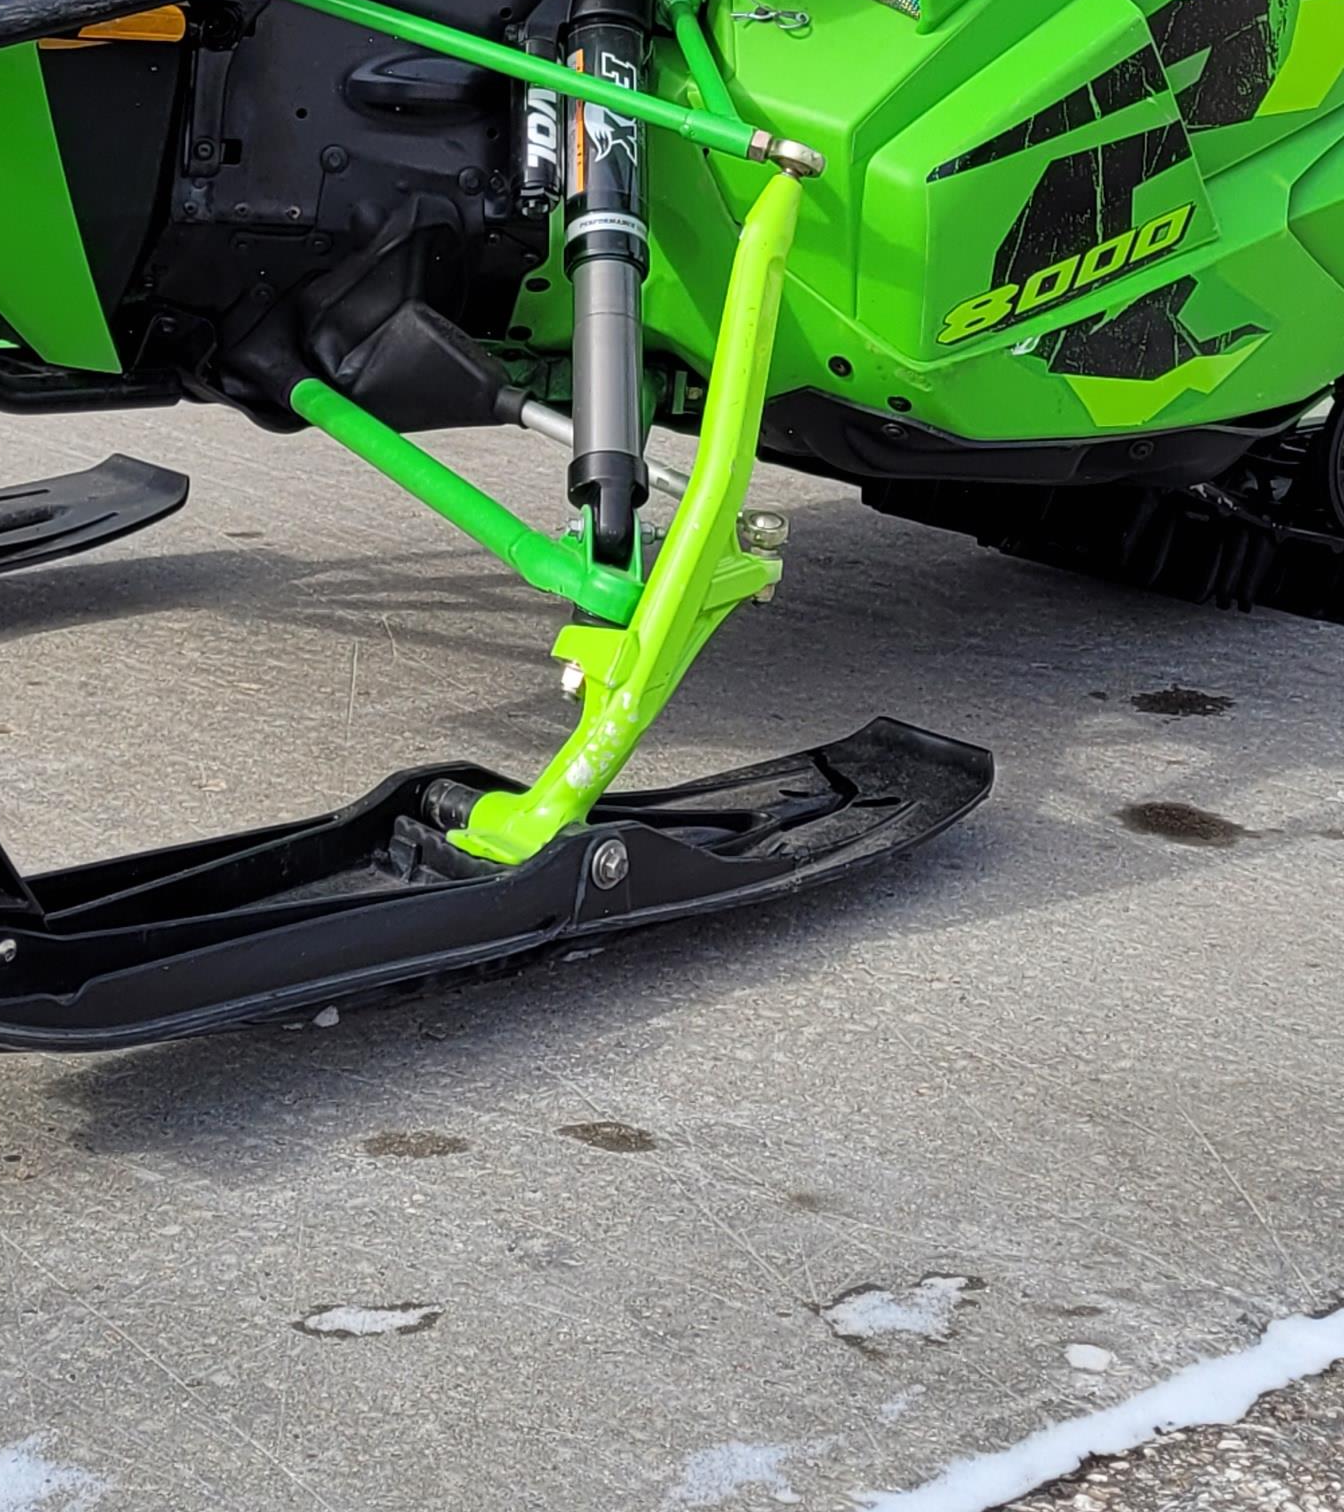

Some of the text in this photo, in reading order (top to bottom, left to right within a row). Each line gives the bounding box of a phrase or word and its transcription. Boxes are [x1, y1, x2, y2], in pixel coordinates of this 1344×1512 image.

[527, 87, 557, 168] VOL
[584, 51, 637, 167] FX
[936, 203, 1194, 344] 8000
